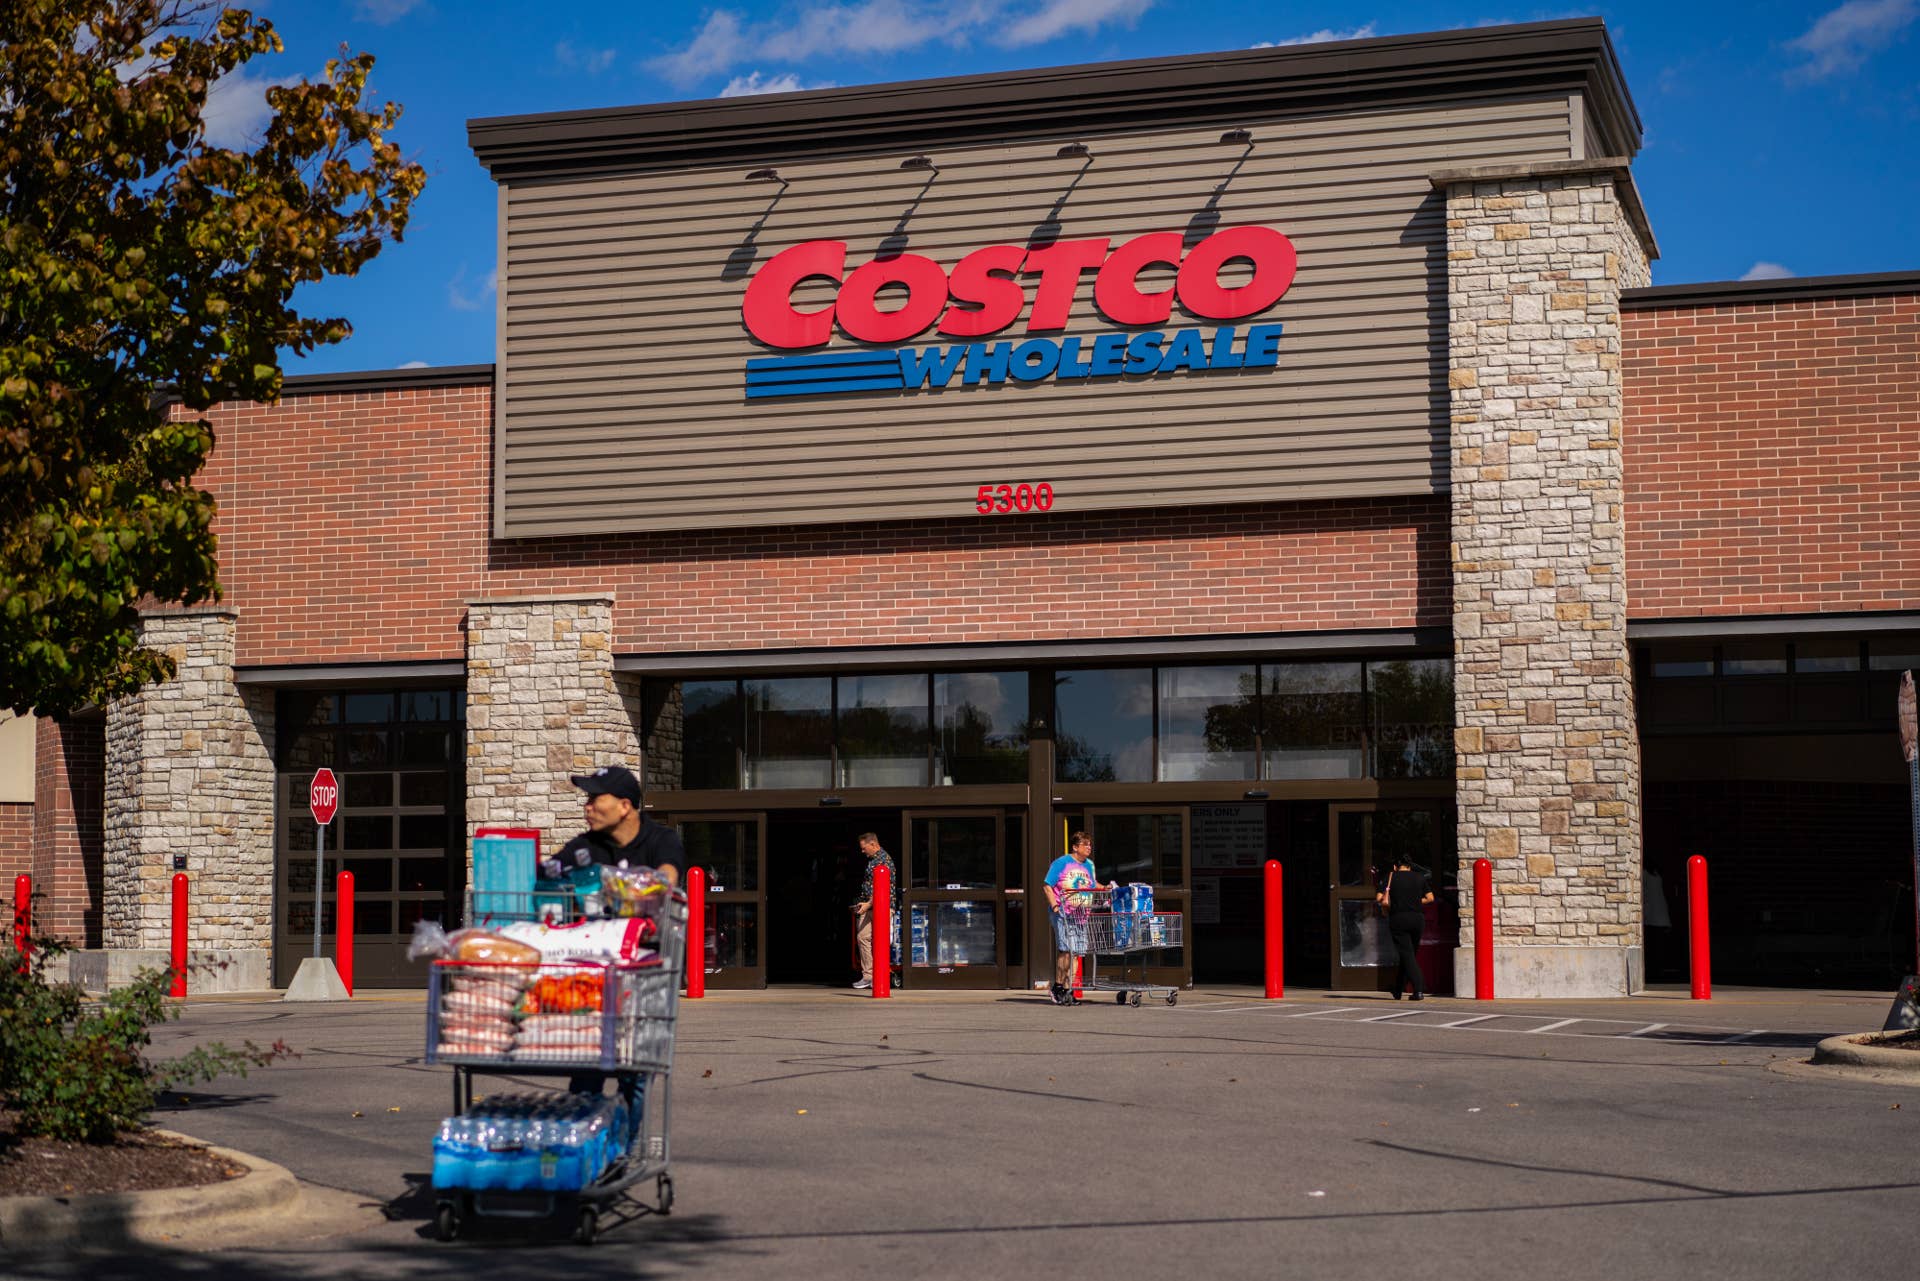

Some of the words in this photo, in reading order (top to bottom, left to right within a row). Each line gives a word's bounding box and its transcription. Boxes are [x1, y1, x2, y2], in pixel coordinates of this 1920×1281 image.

[742, 226, 1298, 349] COSTCO
[899, 324, 1283, 389] WHOLESALE
[976, 482, 1054, 514] 5300
[312, 786, 336, 807] STOP
[1214, 807, 1240, 817] ONLY
